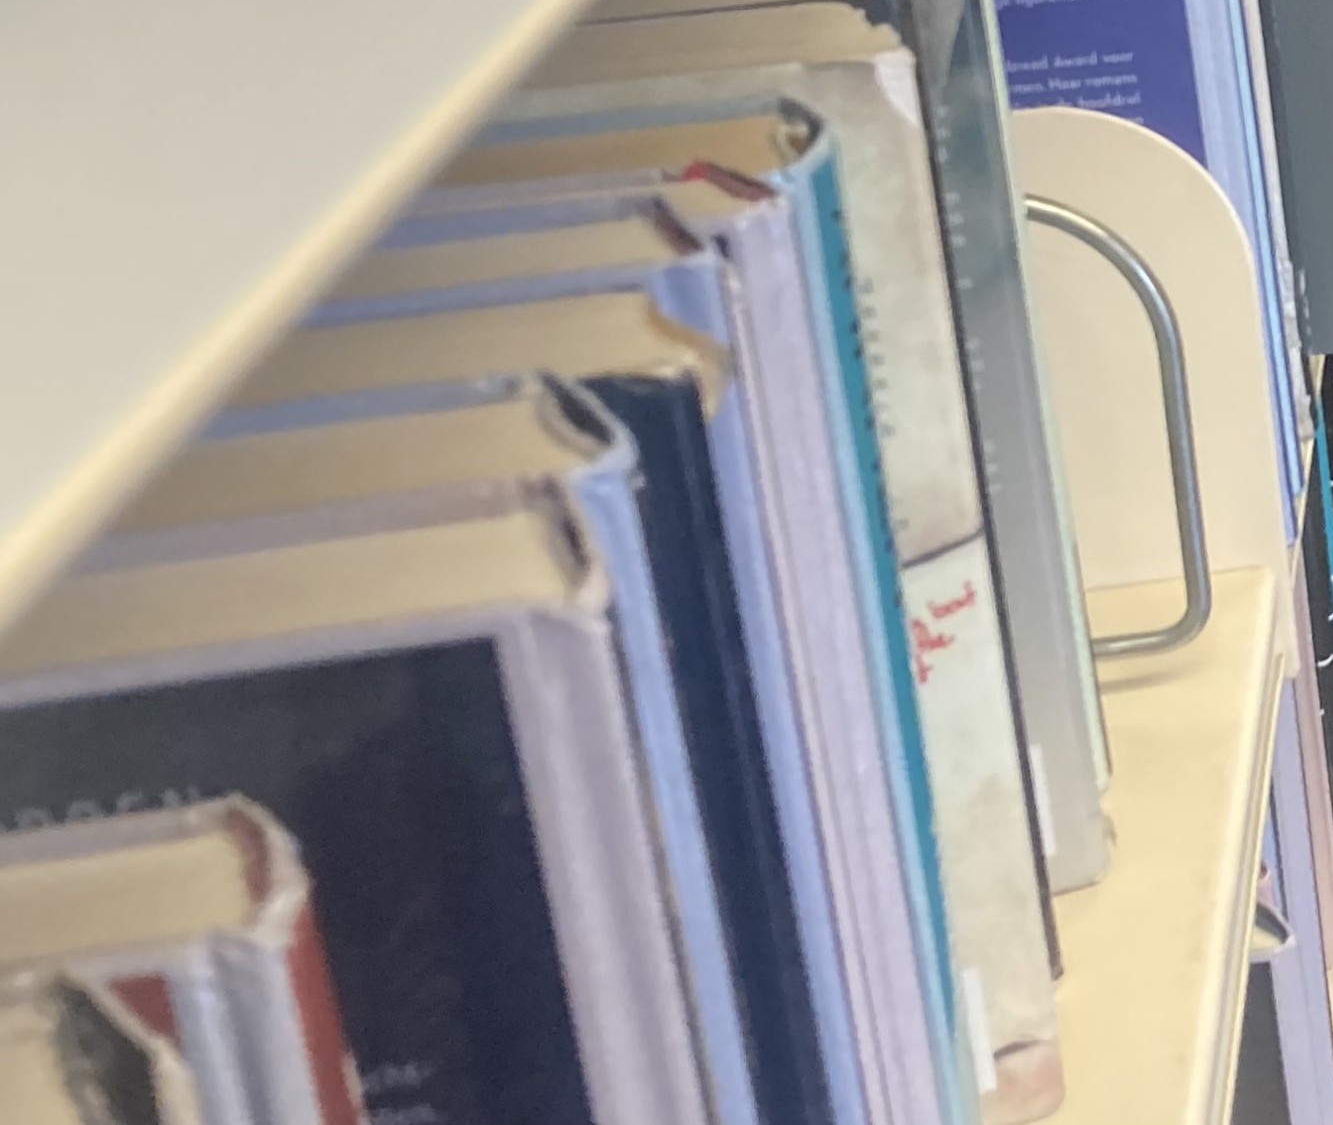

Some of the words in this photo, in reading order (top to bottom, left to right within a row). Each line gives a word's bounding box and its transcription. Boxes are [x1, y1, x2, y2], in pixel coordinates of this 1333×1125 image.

[1054, 50, 1098, 68] Award
[1102, 51, 1134, 63] voor
[1048, 77, 1082, 90] Haar
[1084, 73, 1138, 89] romans
